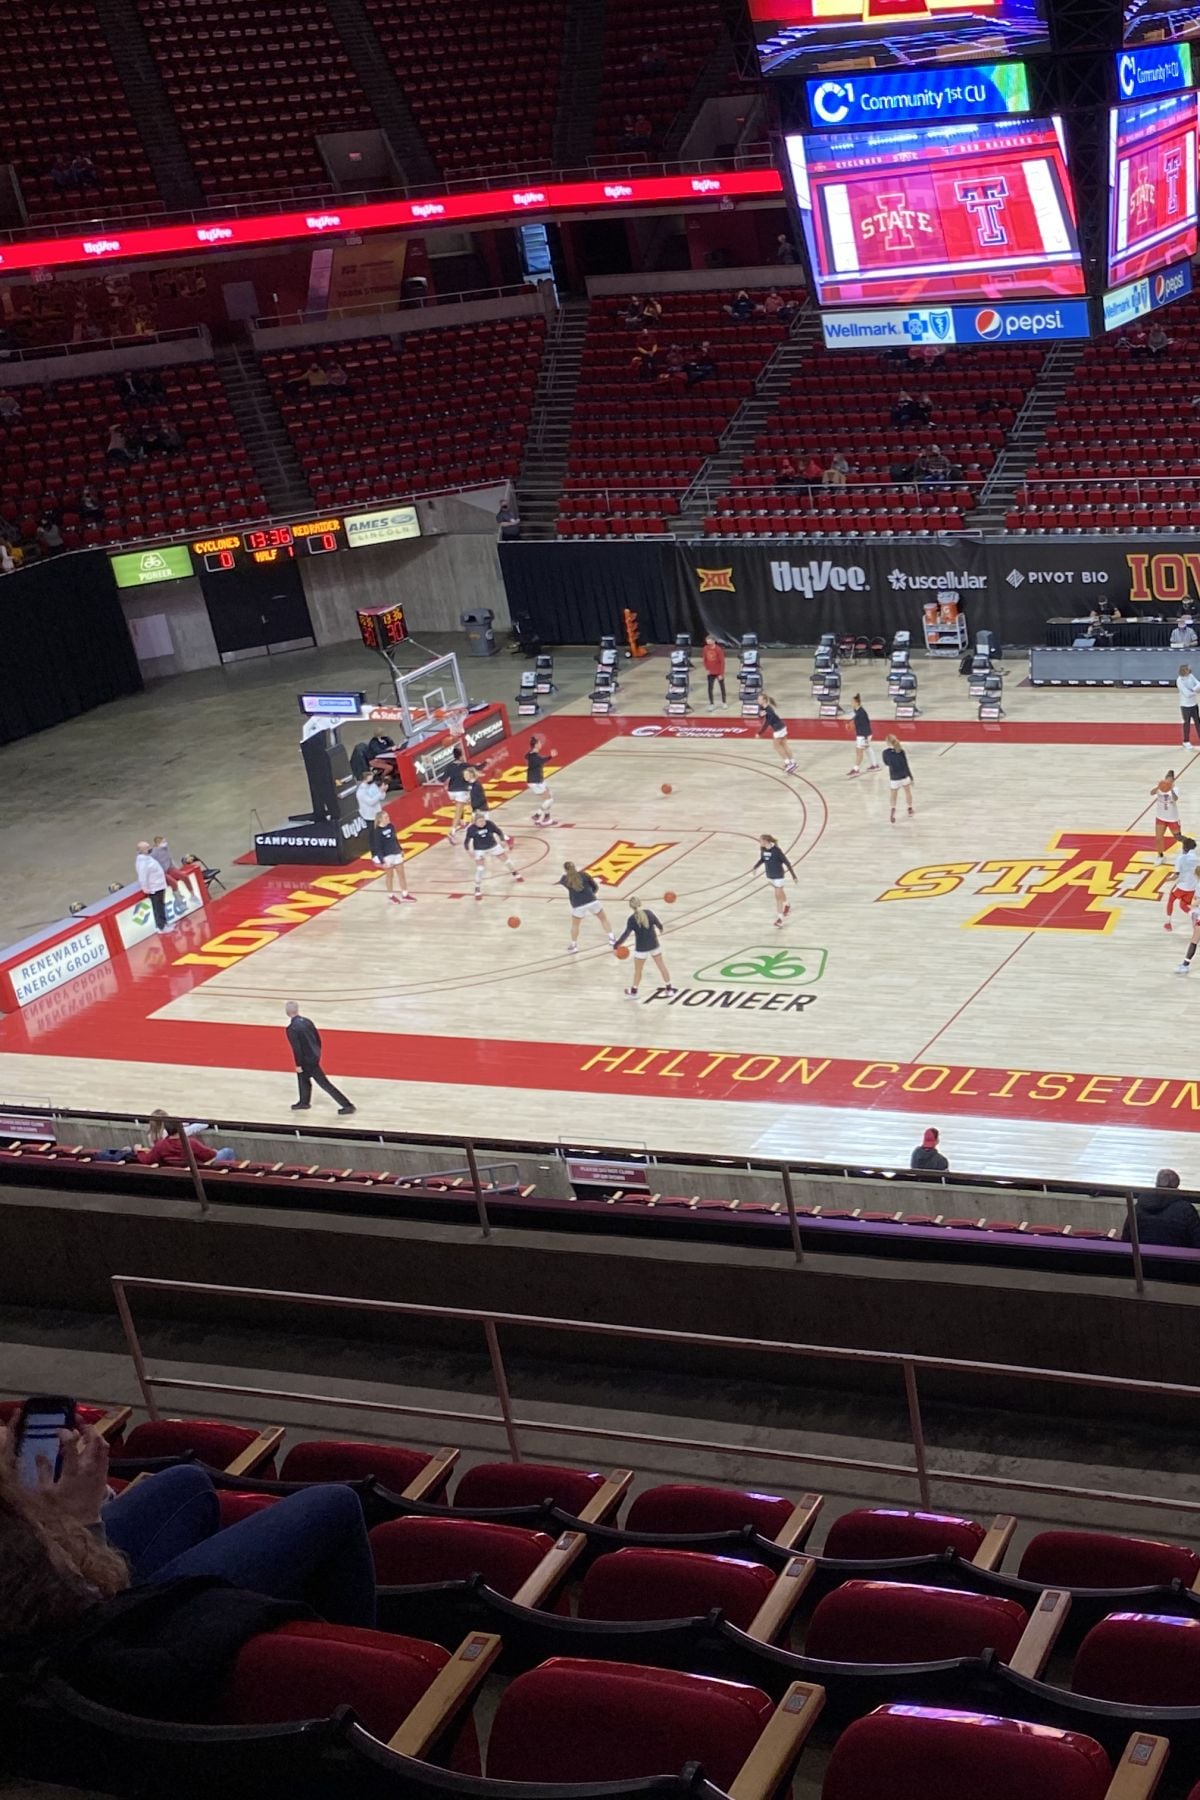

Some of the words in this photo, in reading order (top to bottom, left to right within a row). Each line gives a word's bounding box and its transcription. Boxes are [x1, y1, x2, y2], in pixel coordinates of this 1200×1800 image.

[1137, 64, 1165, 84] Community
[861, 89, 943, 110] Community
[944, 86, 962, 103] 1st
[965, 85, 986, 102] CU
[1130, 184, 1155, 214] STATE
[861, 210, 933, 239] STATE
[1165, 271, 1184, 296] pepsi
[825, 321, 897, 338] Wellmark
[1006, 310, 1064, 336] pepsi
[348, 518, 389, 532] AMES
[194, 536, 240, 554] CYCLONES
[250, 528, 290, 548] 13:36
[323, 534, 332, 550] 0
[221, 552, 232, 568] 0
[255, 550, 277, 562] HALF
[138, 569, 172, 581] PIONEER
[1028, 572, 1073, 584] PIVOT
[1082, 571, 1109, 584] BIO
[668, 726, 748, 734] Community
[256, 836, 336, 847] CAMPUSTOWN
[171, 868, 386, 968] IOWA
[22, 934, 92, 980] RENEWABLE
[16, 970, 62, 1000] ENERGY
[67, 944, 104, 972] GROUP
[644, 987, 818, 1012] PIONEER
[580, 1046, 832, 1084] HILTON
